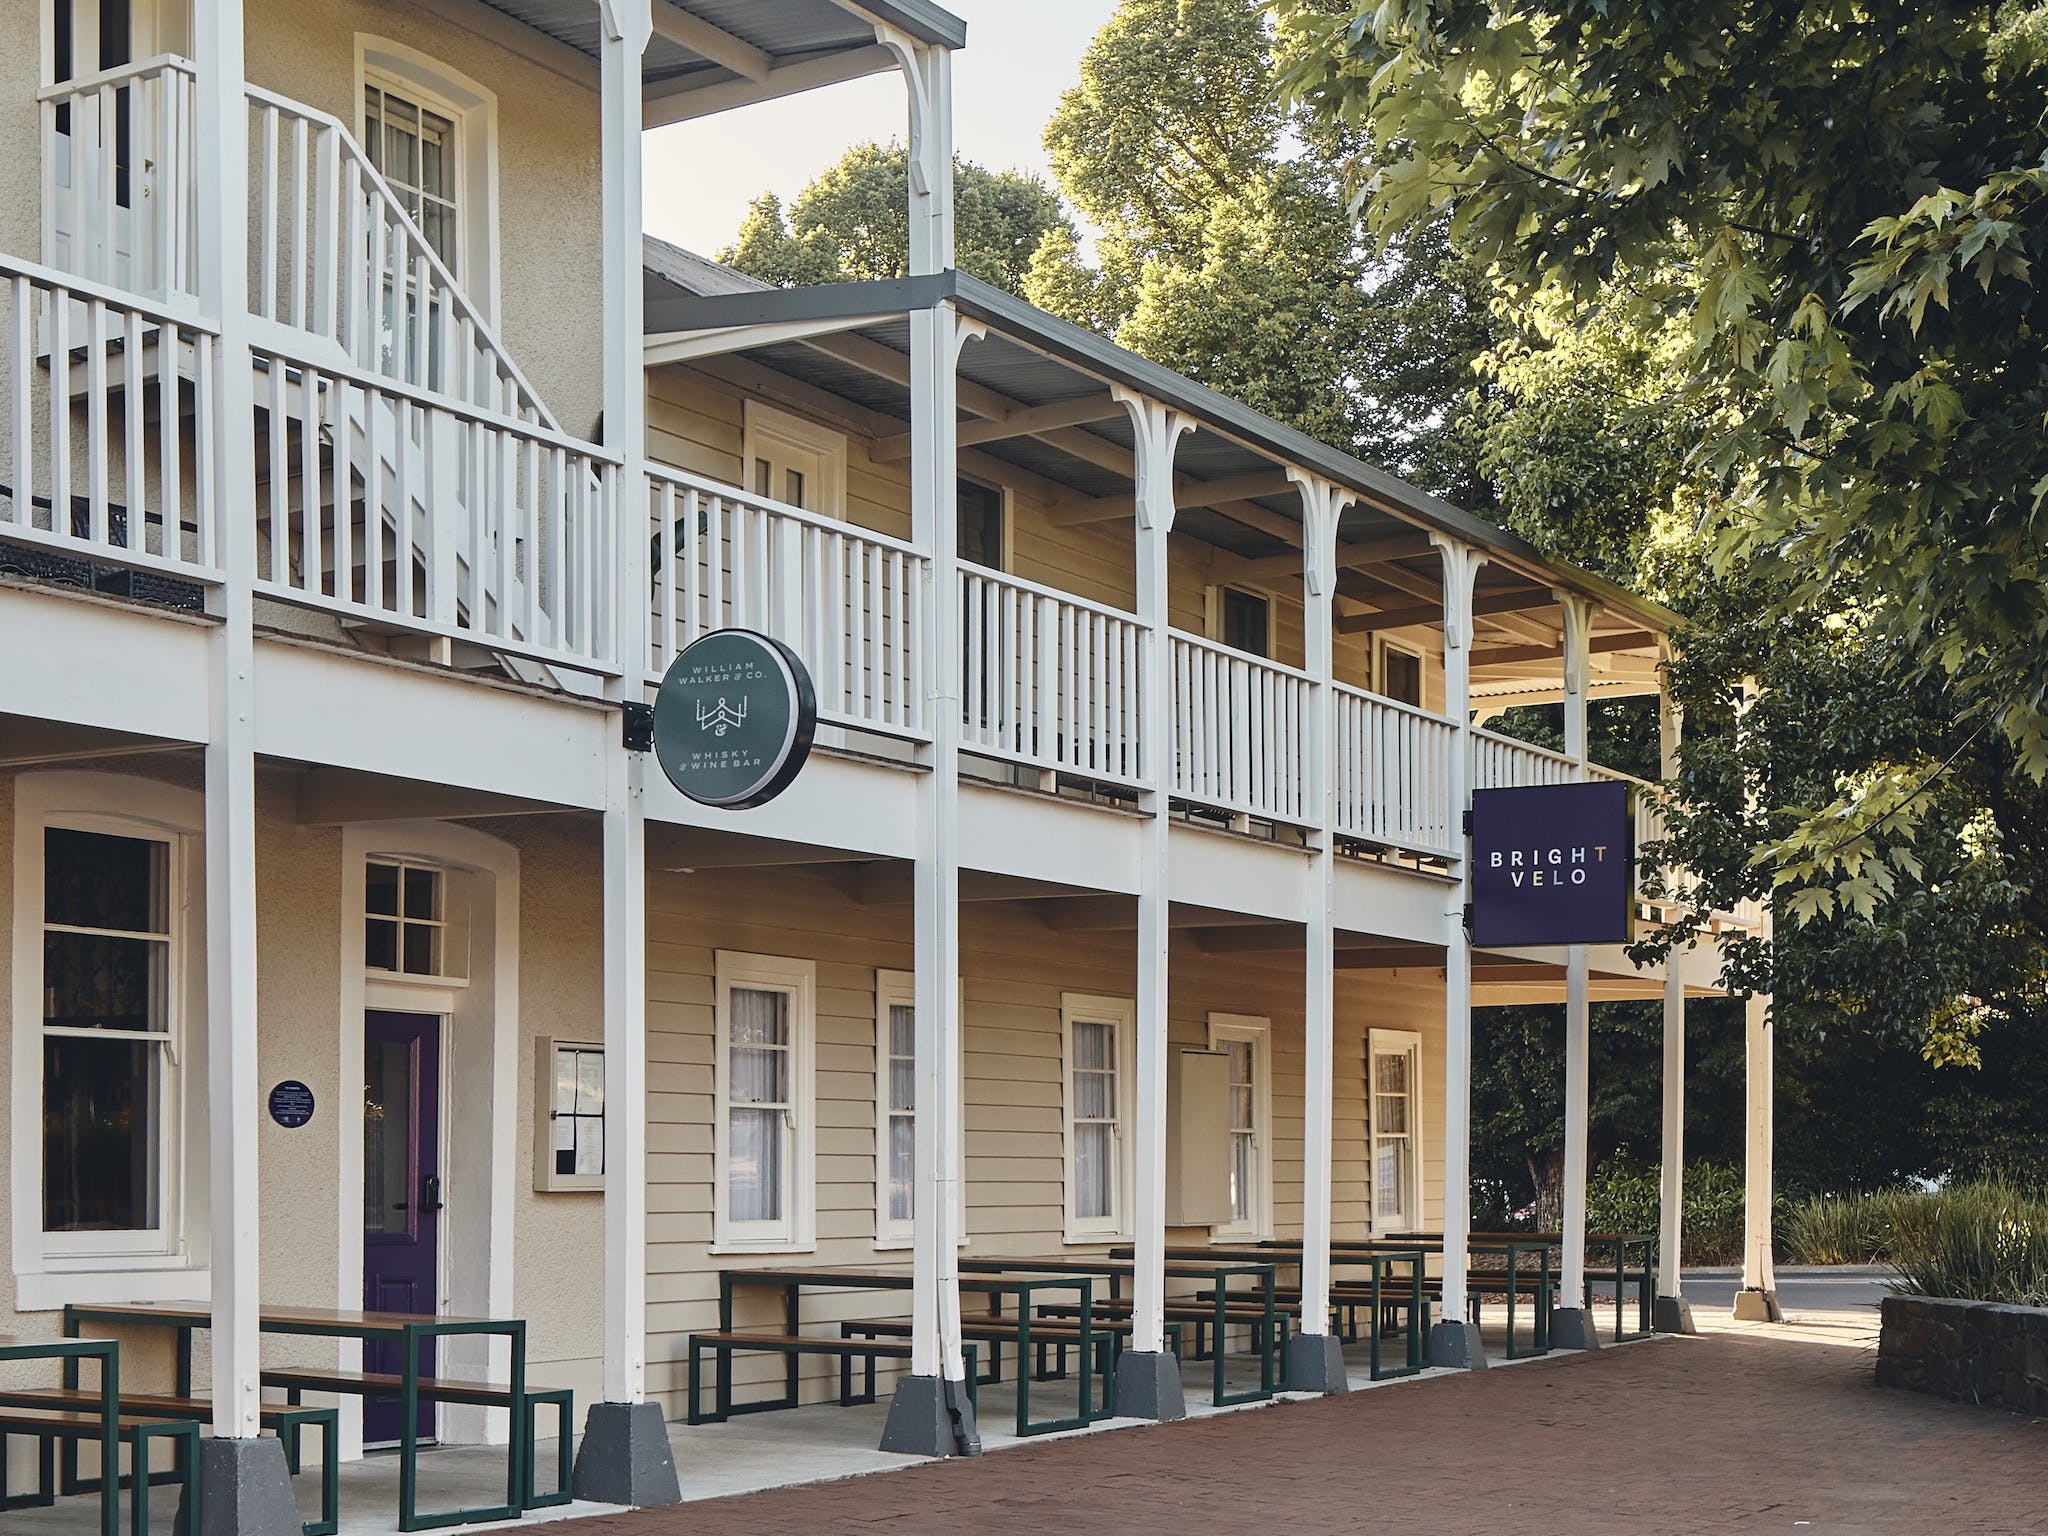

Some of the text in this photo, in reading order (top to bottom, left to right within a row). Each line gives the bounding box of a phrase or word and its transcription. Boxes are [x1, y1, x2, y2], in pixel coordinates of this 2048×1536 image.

[693, 662, 754, 673] WILLIAM
[678, 674, 730, 685] WALKER
[746, 671, 767, 680] CO.
[692, 750, 749, 760] WHISKY
[691, 761, 727, 770] WINE
[733, 758, 761, 768] BAR
[1490, 846, 1607, 868] BRIGHT
[1511, 869, 1586, 888] VELO
